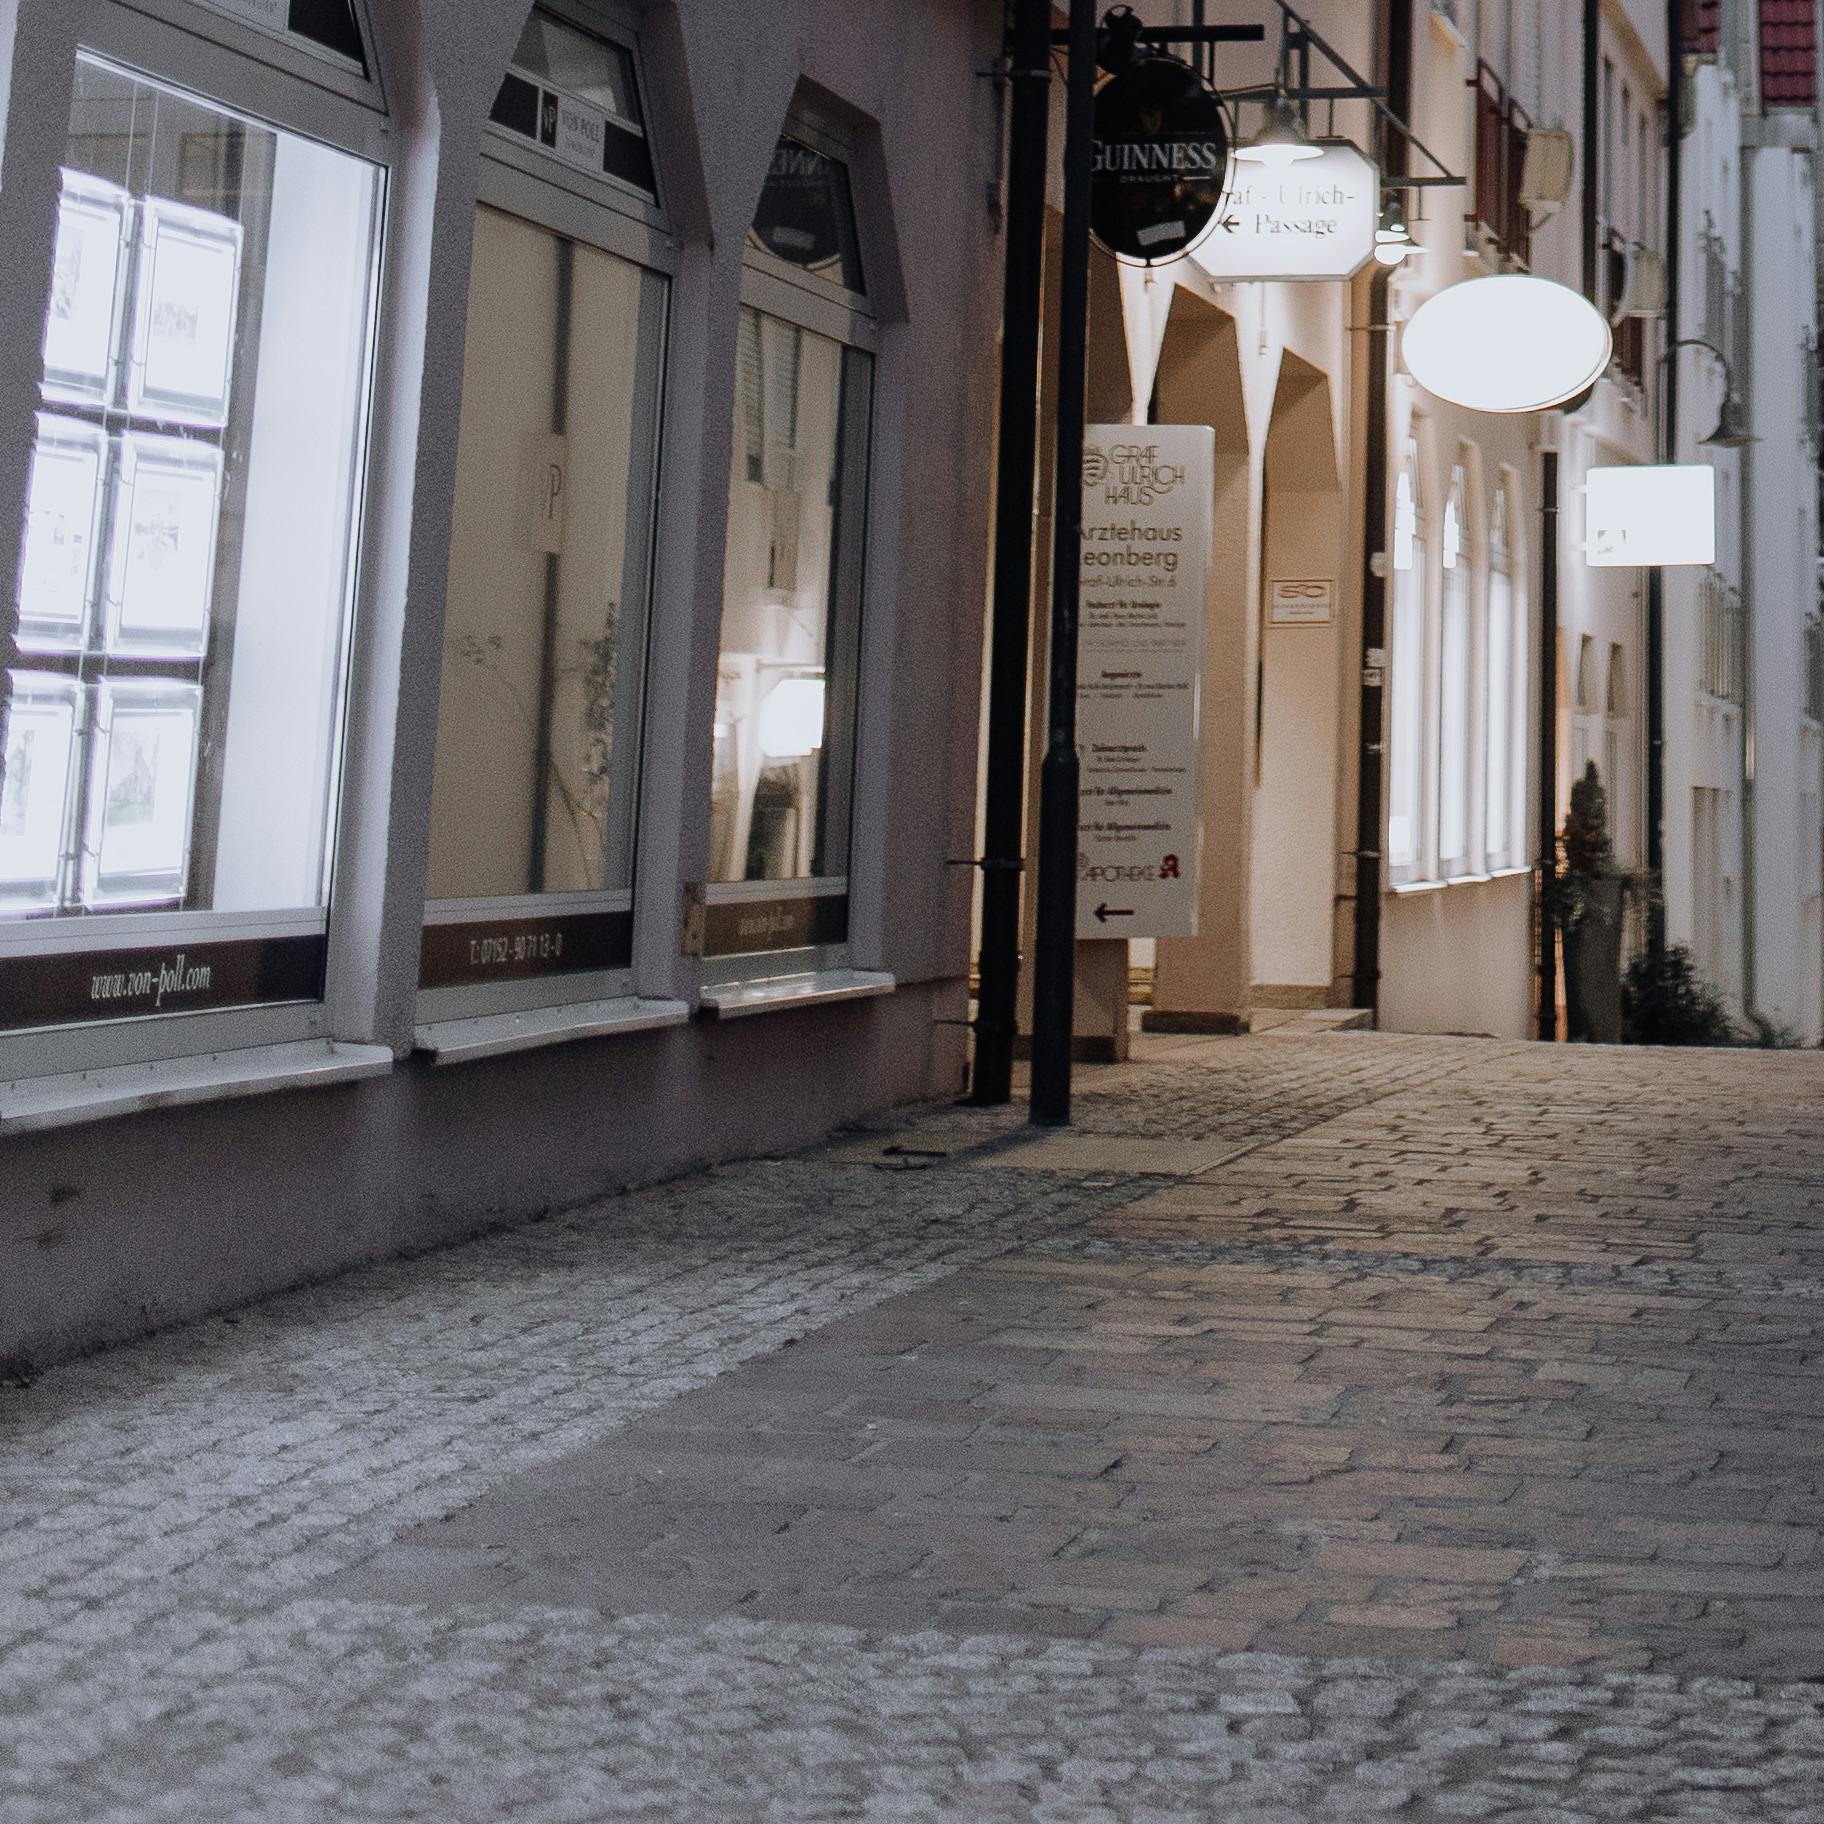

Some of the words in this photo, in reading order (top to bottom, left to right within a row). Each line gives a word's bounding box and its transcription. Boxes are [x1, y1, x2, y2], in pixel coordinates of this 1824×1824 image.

[1255, 213, 1338, 239] Passage
[1108, 444, 1161, 464] GRAF
[1080, 544, 1178, 572] eonberg
[90, 953, 212, 1007] www.von-poll.com
